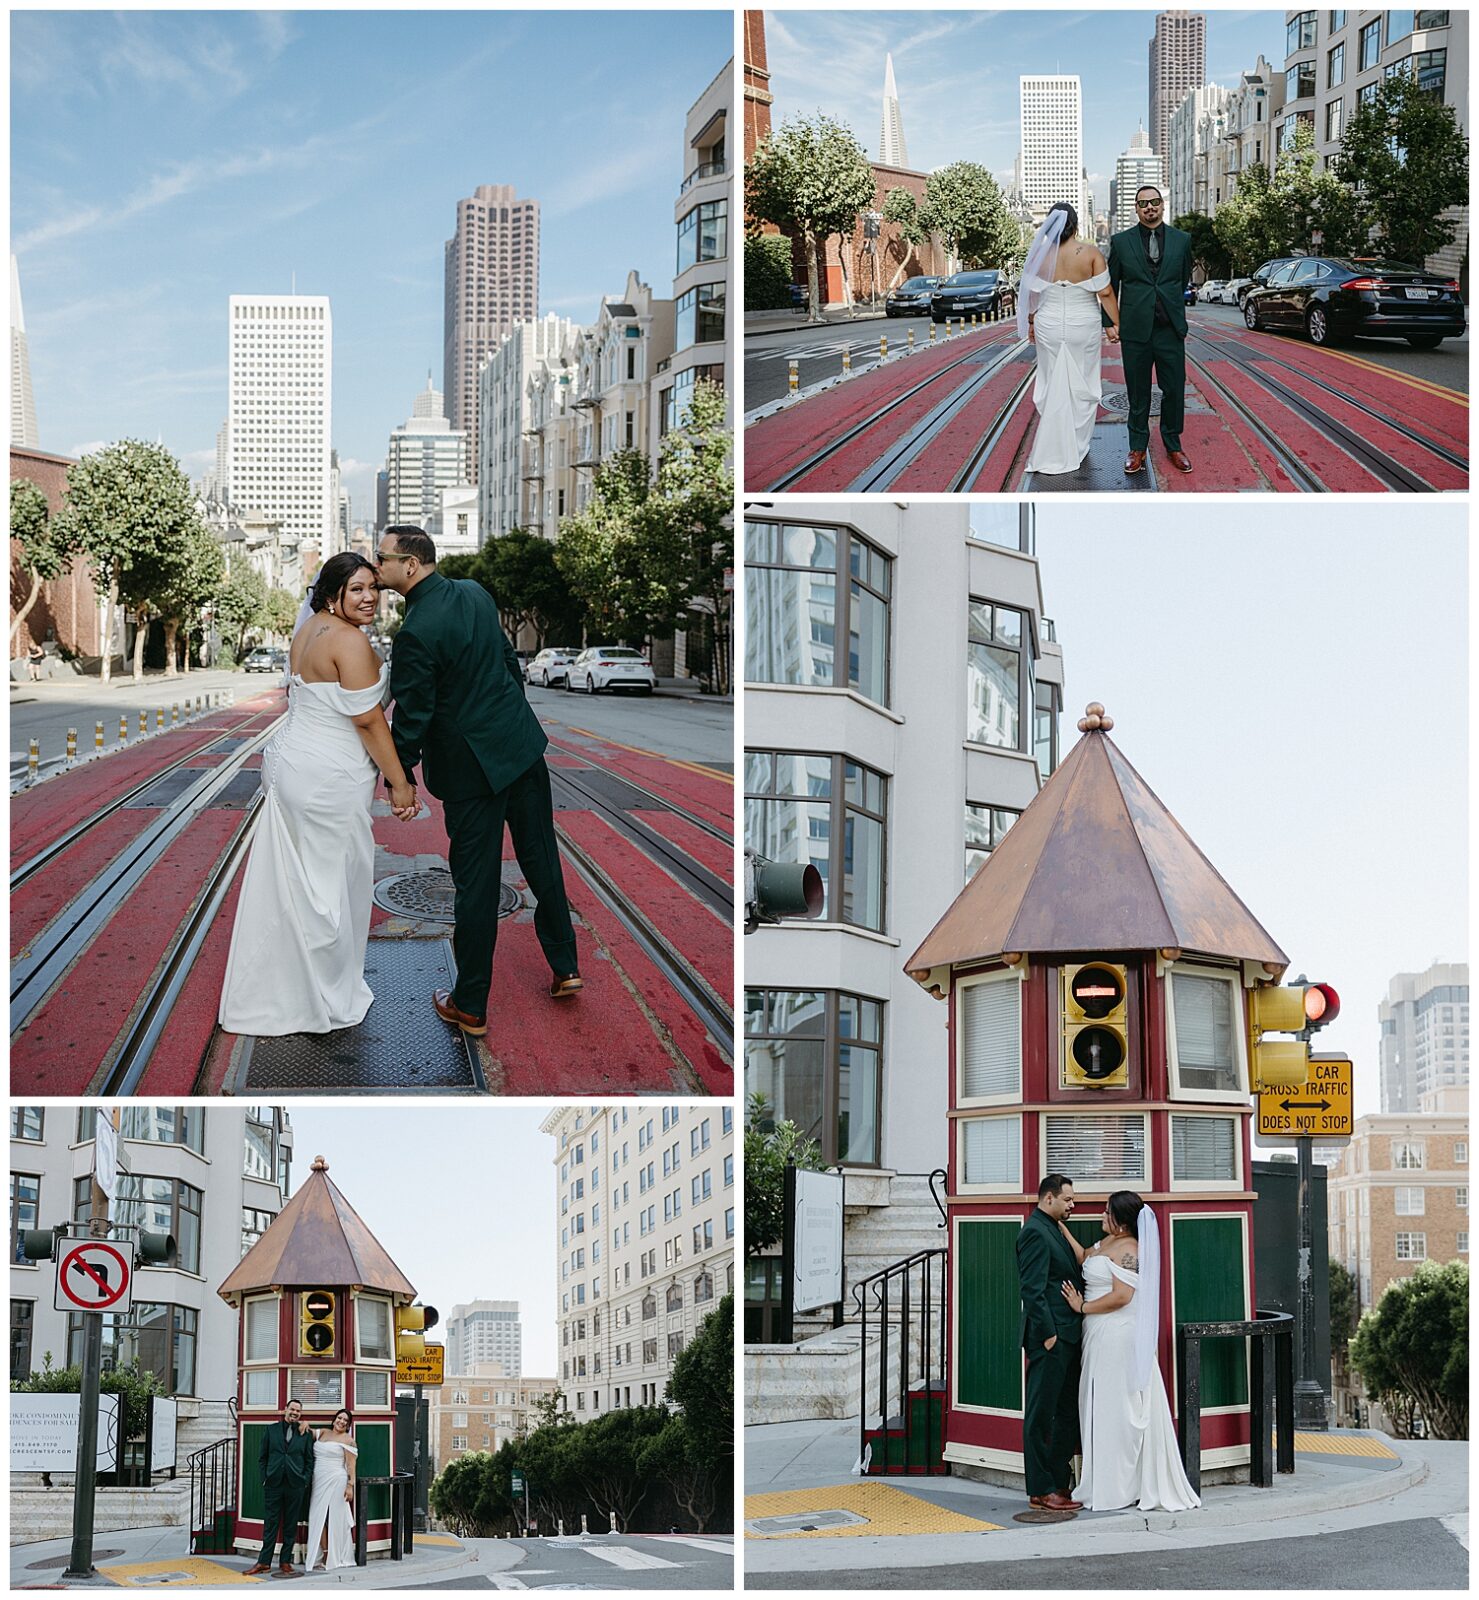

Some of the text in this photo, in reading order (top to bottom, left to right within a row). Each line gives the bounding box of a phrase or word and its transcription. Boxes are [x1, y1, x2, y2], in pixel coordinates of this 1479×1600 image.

[1315, 1066, 1339, 1079] CAR
[1305, 1082, 1348, 1095] TRAFFIC
[1262, 1115, 1348, 1129] DOES NOT STOP
[428, 1373, 441, 1381] STOP
